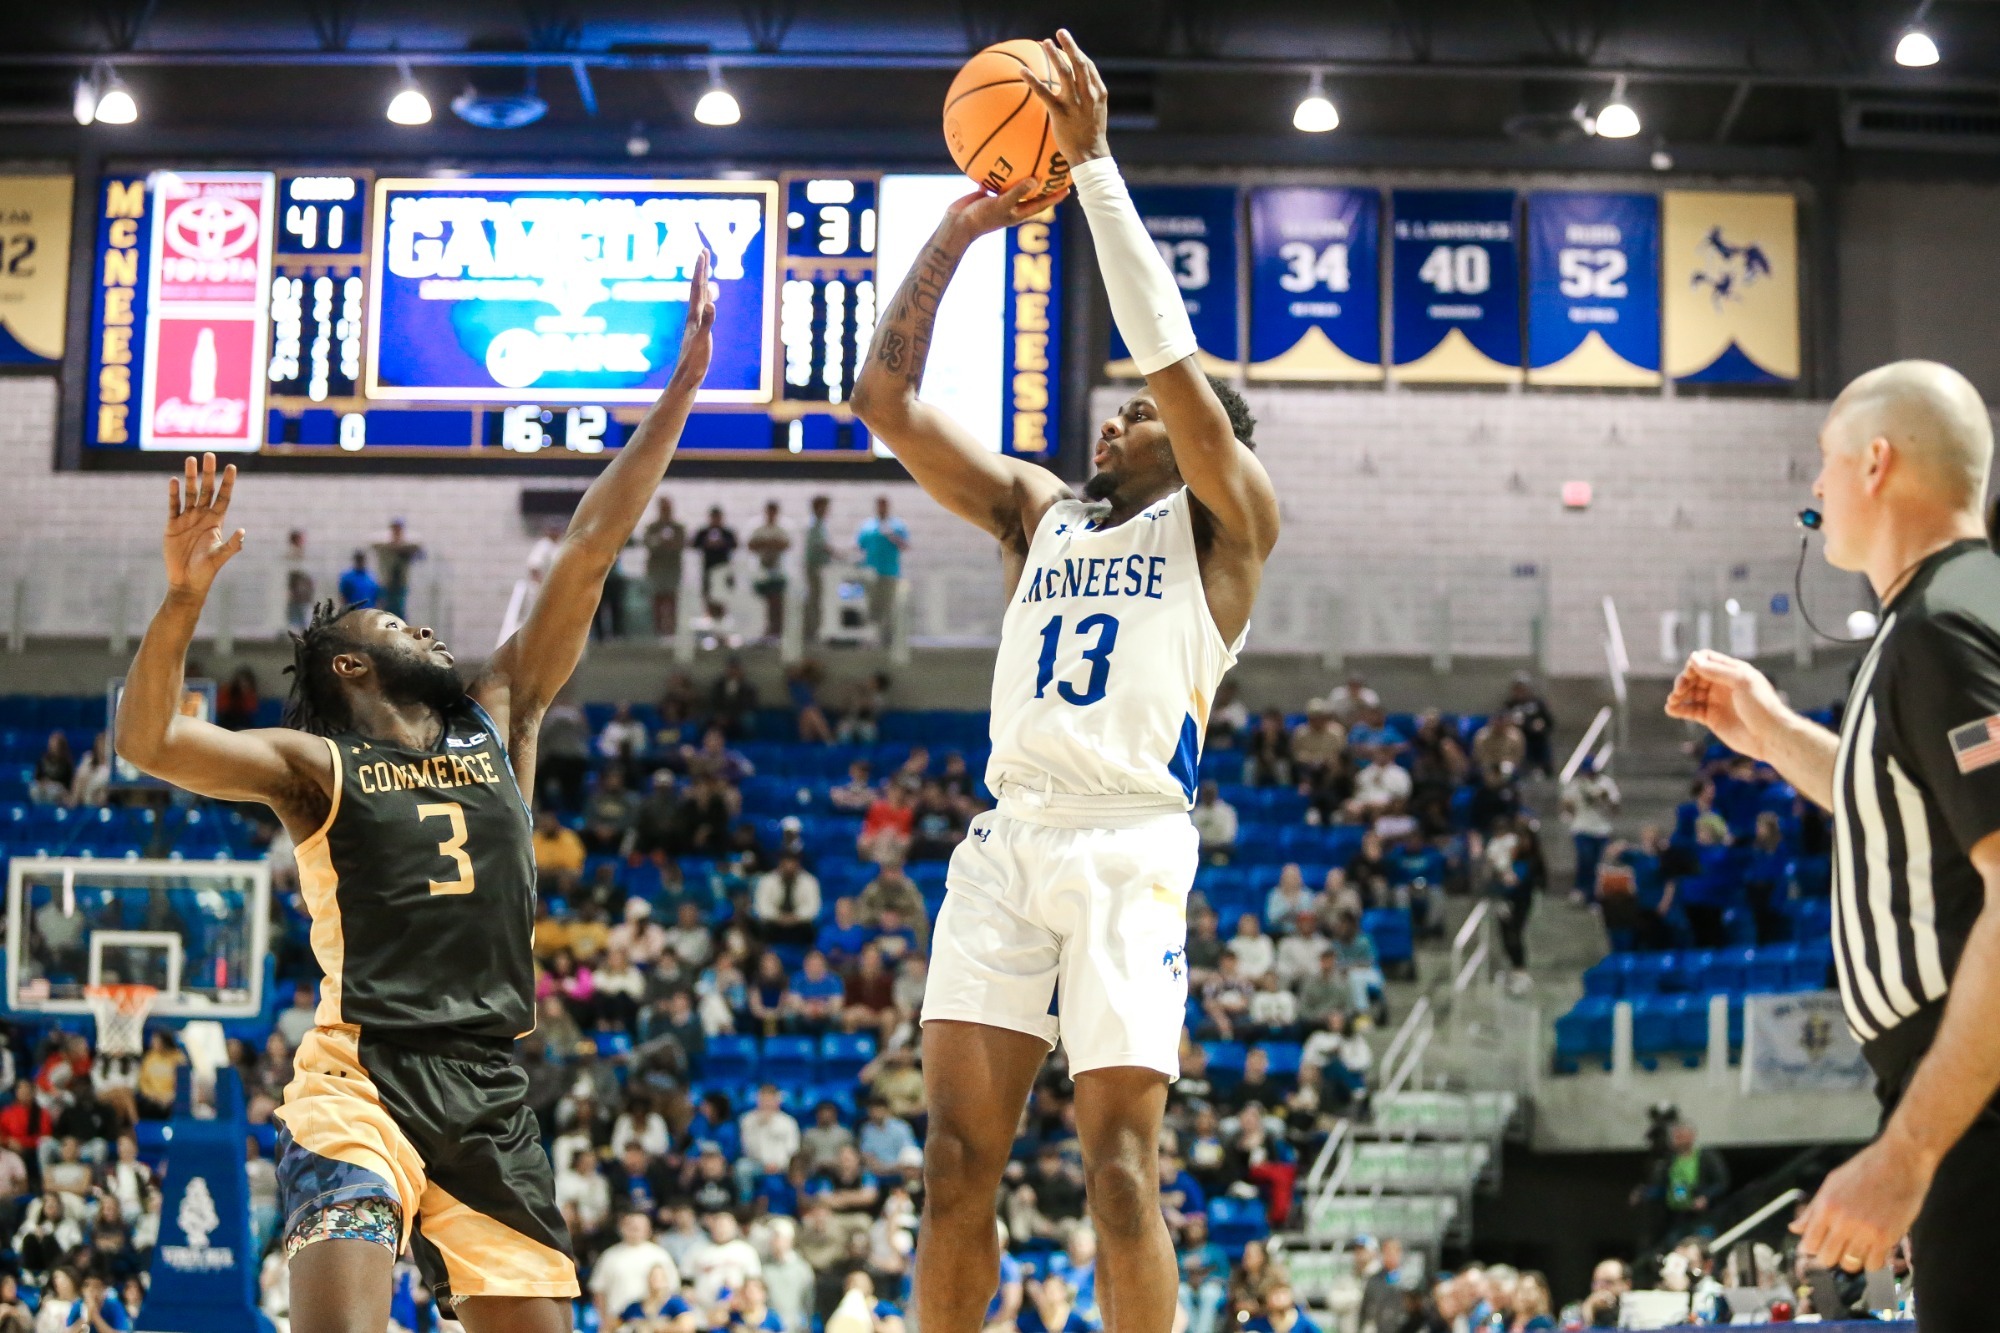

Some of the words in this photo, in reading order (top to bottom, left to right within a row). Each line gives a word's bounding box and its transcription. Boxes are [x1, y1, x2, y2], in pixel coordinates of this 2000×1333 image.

[286, 205, 344, 249] 41
[818, 206, 876, 254] 31
[162, 257, 258, 282] TOYOTA
[1278, 242, 1350, 293] 34
[1418, 244, 1491, 295] 40
[1559, 248, 1629, 298] 52
[1033, 613, 1119, 707] 13
[358, 752, 500, 794] COMMERCE
[416, 802, 475, 896] 3
